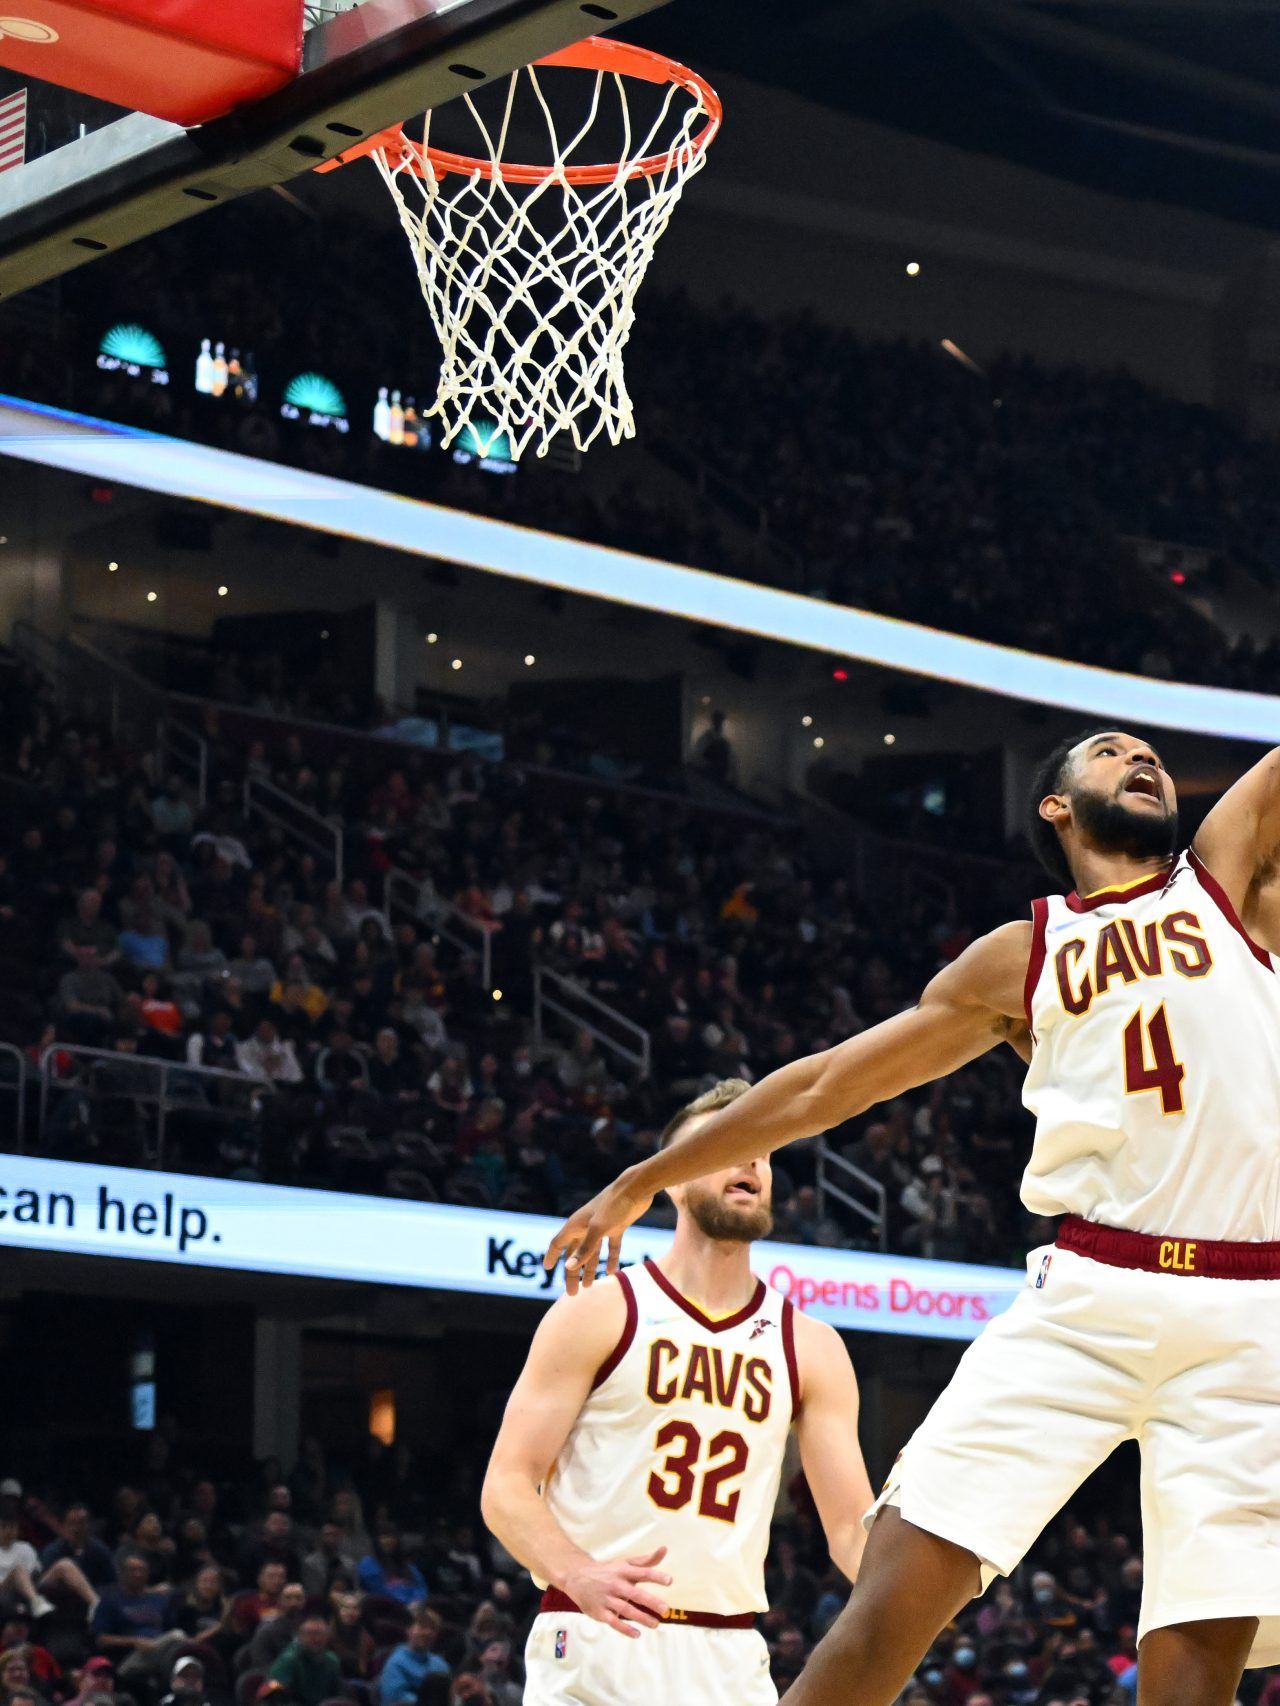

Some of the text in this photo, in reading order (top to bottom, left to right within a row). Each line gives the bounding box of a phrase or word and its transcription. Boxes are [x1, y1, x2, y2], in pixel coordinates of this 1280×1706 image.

[1054, 910, 1216, 1020] CAVS
[1121, 1000, 1187, 1117] 4
[98, 1186, 222, 1252] help.
[1158, 1240, 1197, 1271] CLE
[769, 1265, 879, 1311] Opens
[646, 1338, 772, 1424] CAVS
[646, 1418, 750, 1526] 32
